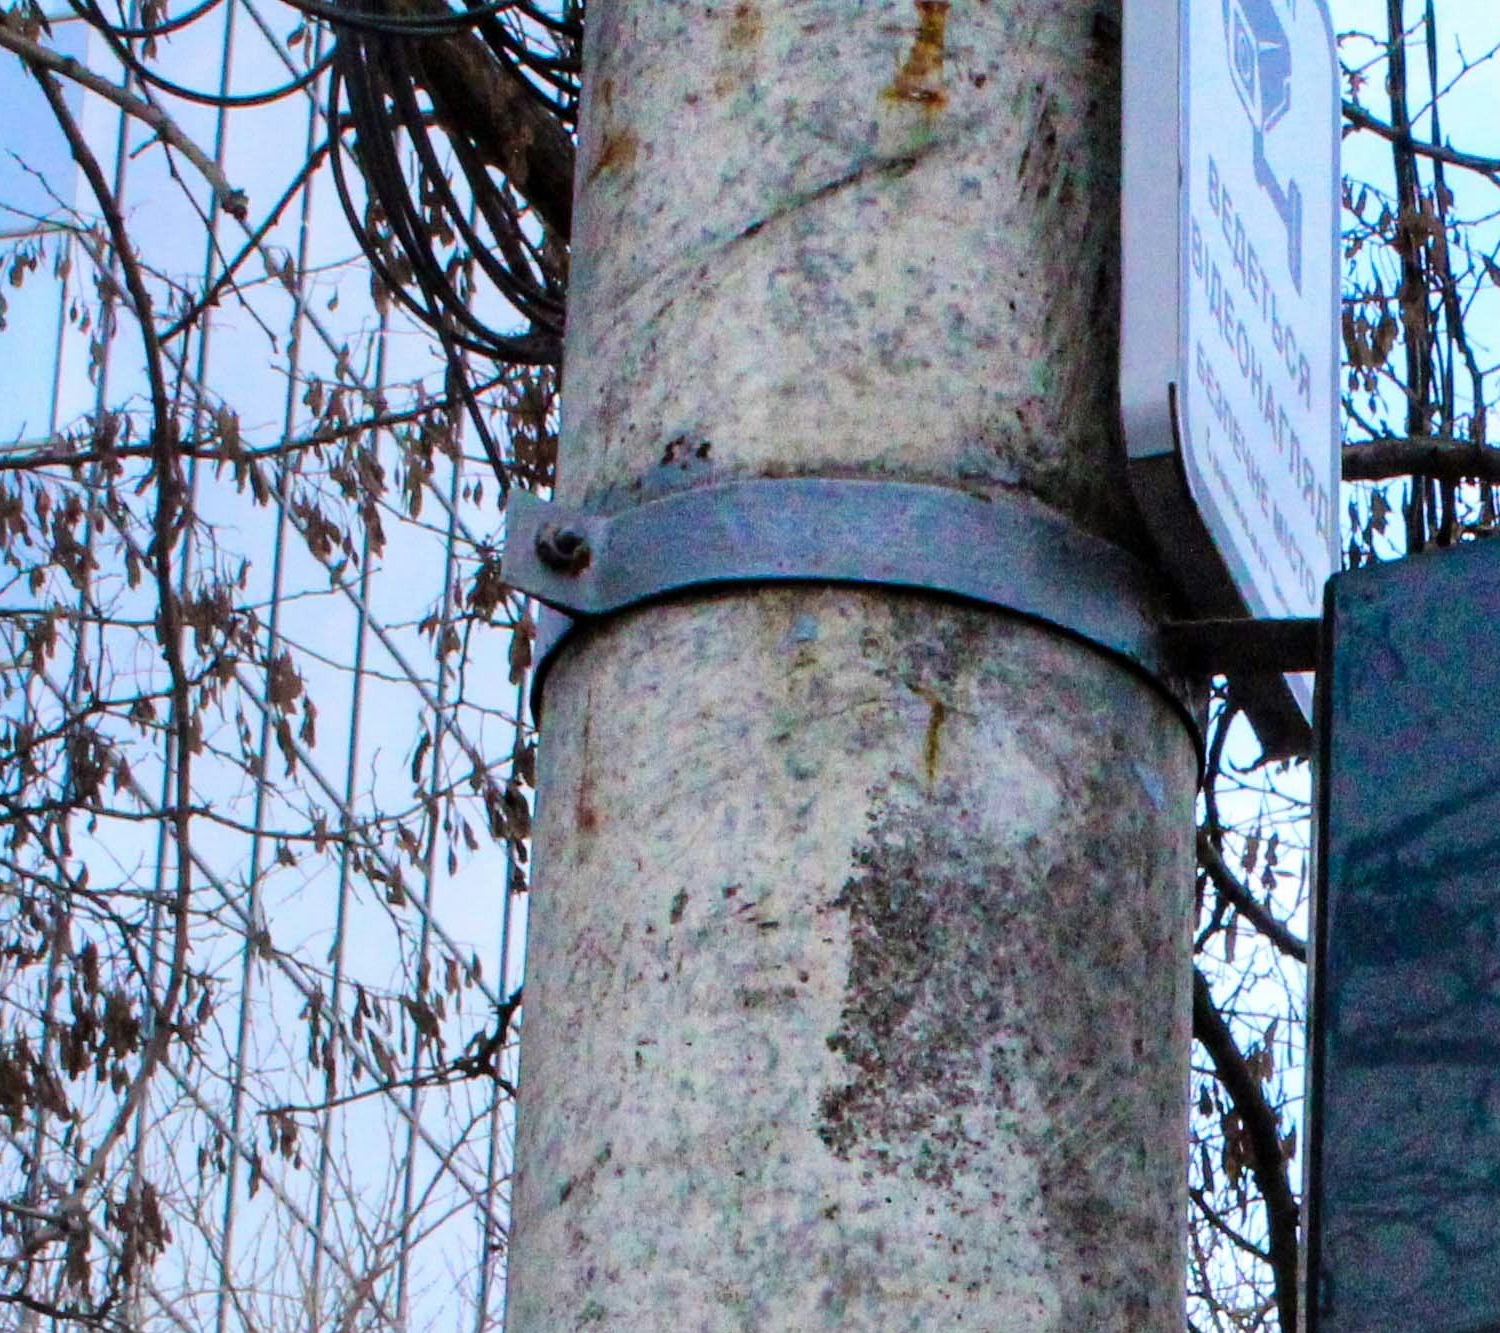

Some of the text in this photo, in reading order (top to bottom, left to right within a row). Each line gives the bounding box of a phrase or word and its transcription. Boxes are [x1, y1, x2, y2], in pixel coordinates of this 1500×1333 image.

[1191, 214, 1329, 550] ВІДЕОНАГЛЯД
[1208, 153, 1311, 411] ВЕДЕТЬСЯ
[1196, 338, 1269, 519] БЕЗПЕЧНЕ
[1272, 500, 1317, 606] МІСТО
